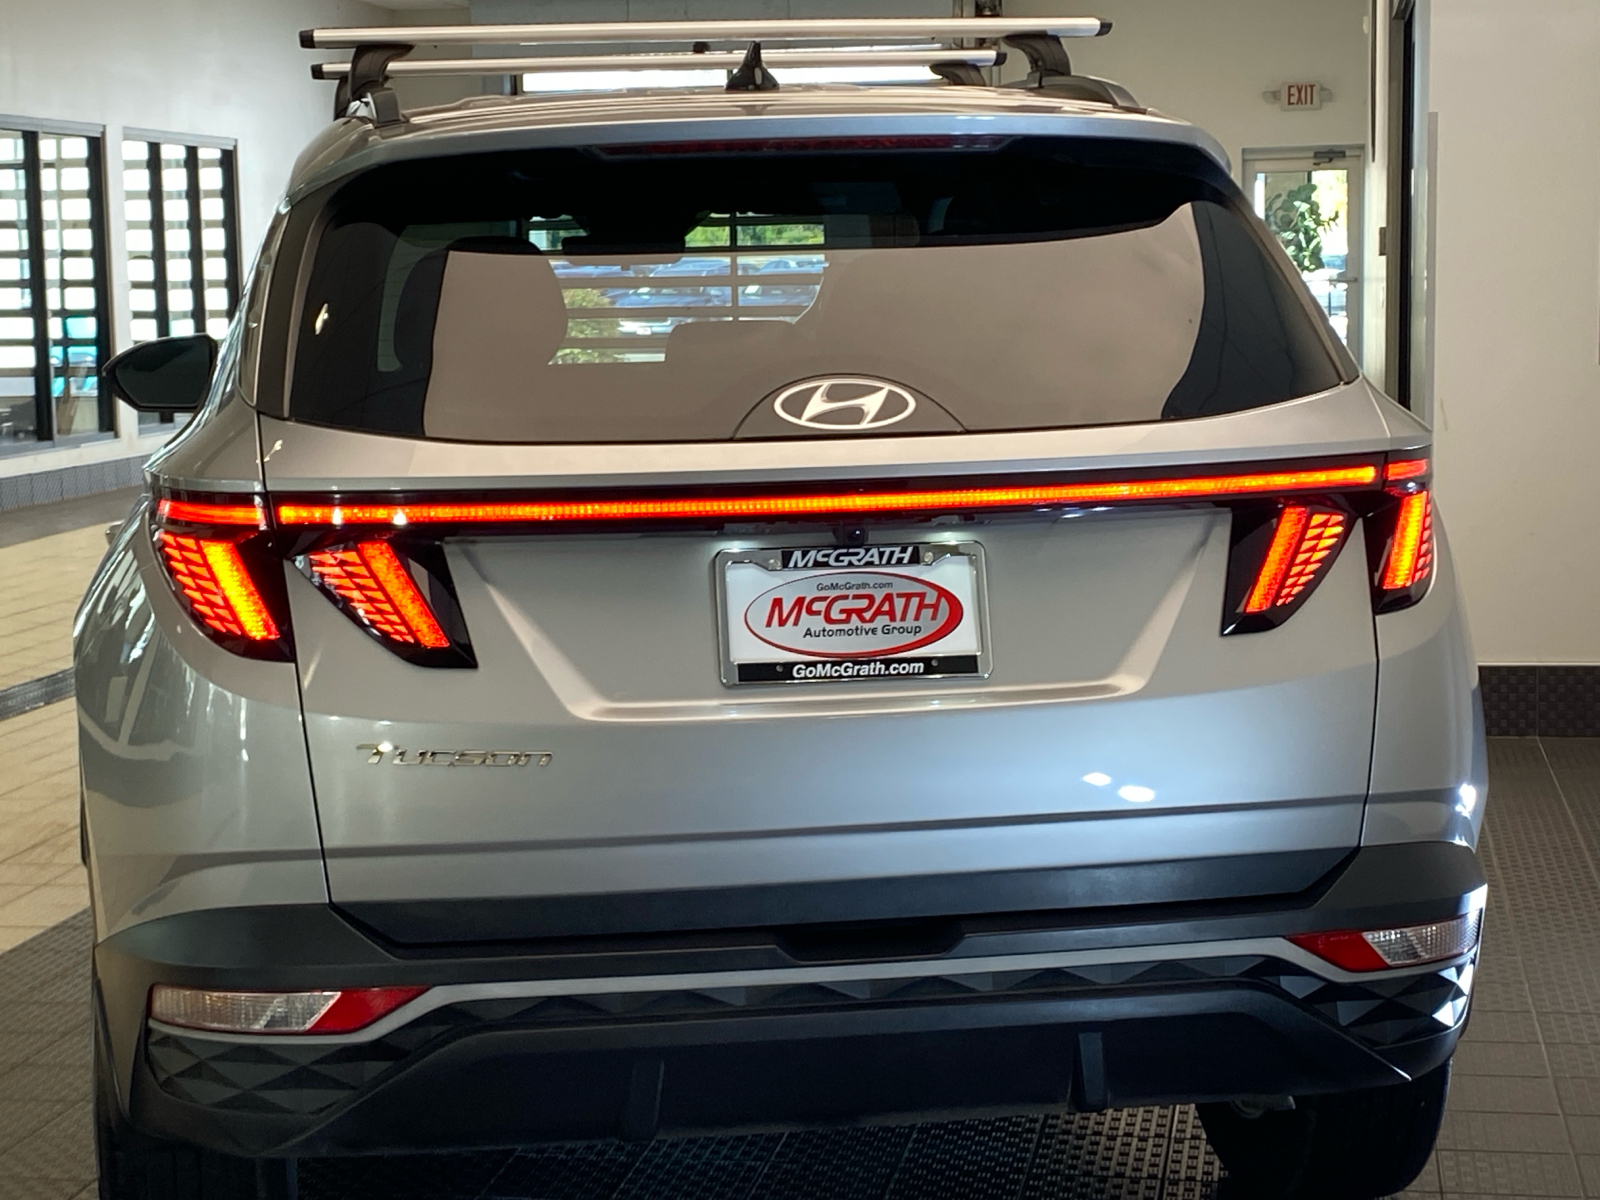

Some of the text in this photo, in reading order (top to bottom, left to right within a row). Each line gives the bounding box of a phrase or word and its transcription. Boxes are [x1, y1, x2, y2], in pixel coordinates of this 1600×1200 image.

[1287, 84, 1316, 106] EXIT
[816, 581, 893, 592] GoMcGrath.com
[803, 624, 922, 638] Automotive Group
[792, 661, 925, 678] GoMcGrath.com
